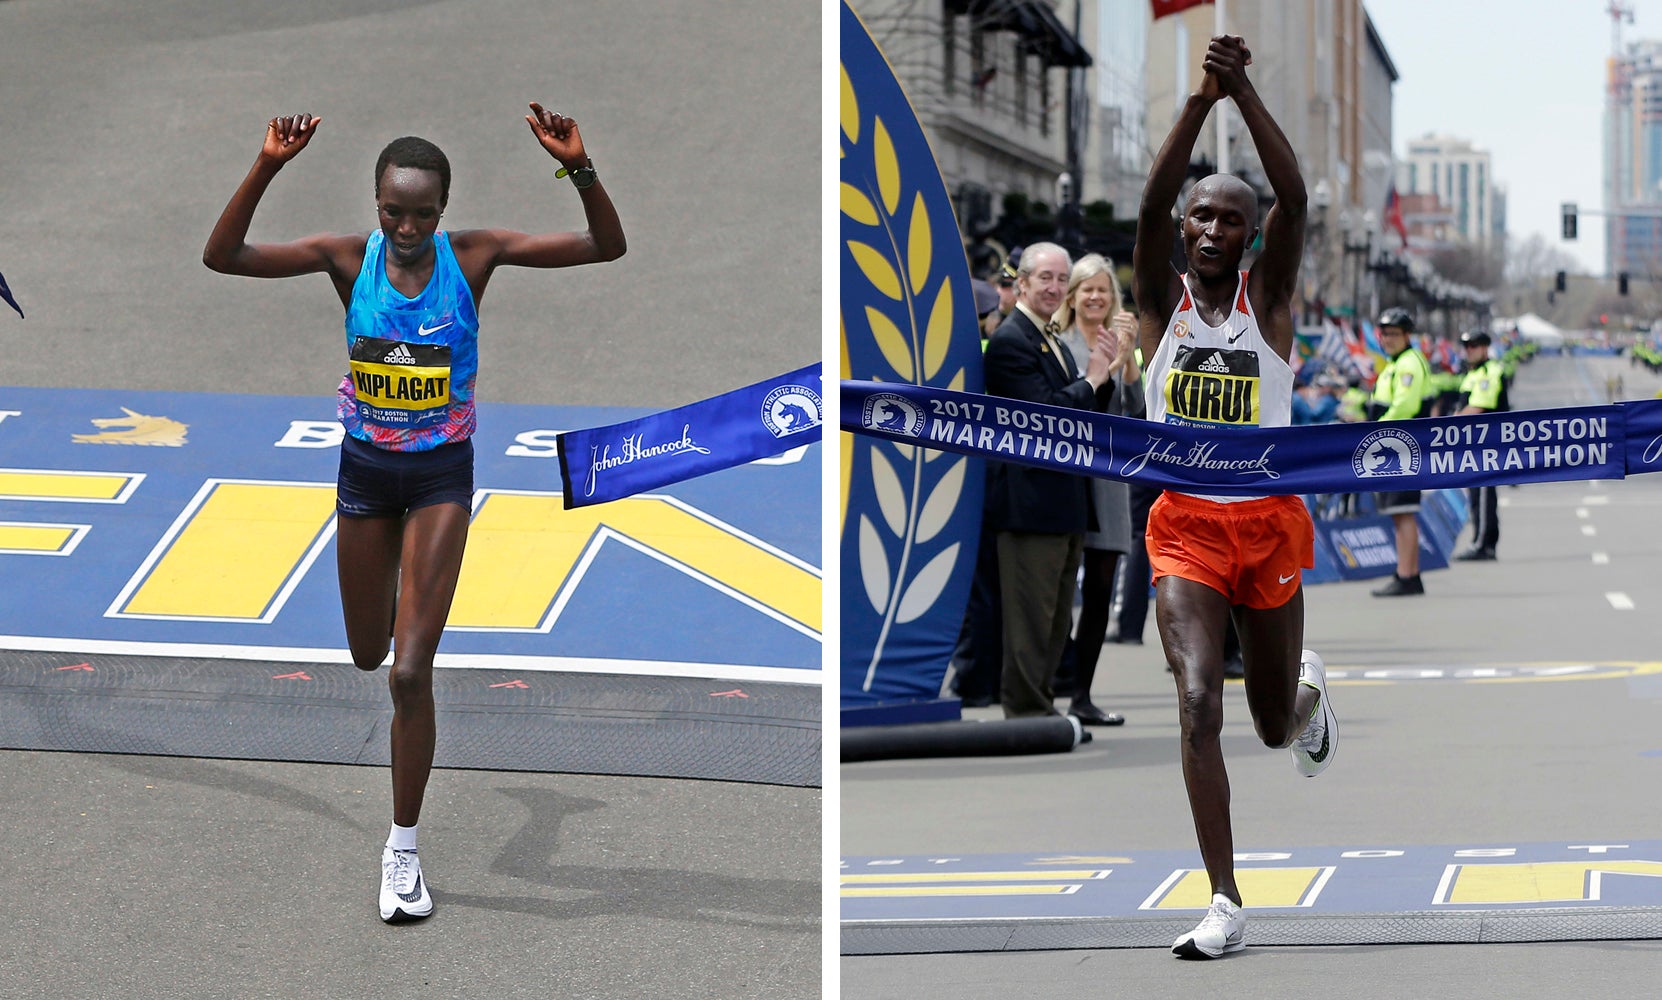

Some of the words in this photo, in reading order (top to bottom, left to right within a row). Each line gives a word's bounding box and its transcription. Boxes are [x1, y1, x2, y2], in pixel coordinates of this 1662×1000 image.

[384, 355, 416, 365] adidas
[1198, 364, 1230, 373] adidas
[355, 370, 447, 401] KIPLAGAT
[764, 388, 790, 411] ATHLETIC
[1171, 374, 1253, 421] KIRUI
[372, 414, 409, 423] MARATHON
[864, 401, 874, 425] BOSTON
[930, 399, 985, 421] 2017
[995, 406, 1094, 442] BOSTON
[929, 418, 1095, 467] MARATHON
[1430, 423, 1489, 447] 2017
[1500, 417, 1607, 443] BOSTON
[1354, 448, 1365, 474] BOSTON
[1362, 430, 1396, 449] ATHLETIC
[1395, 431, 1420, 471] ASSOCIATION
[1430, 443, 1607, 474] MARATHON
